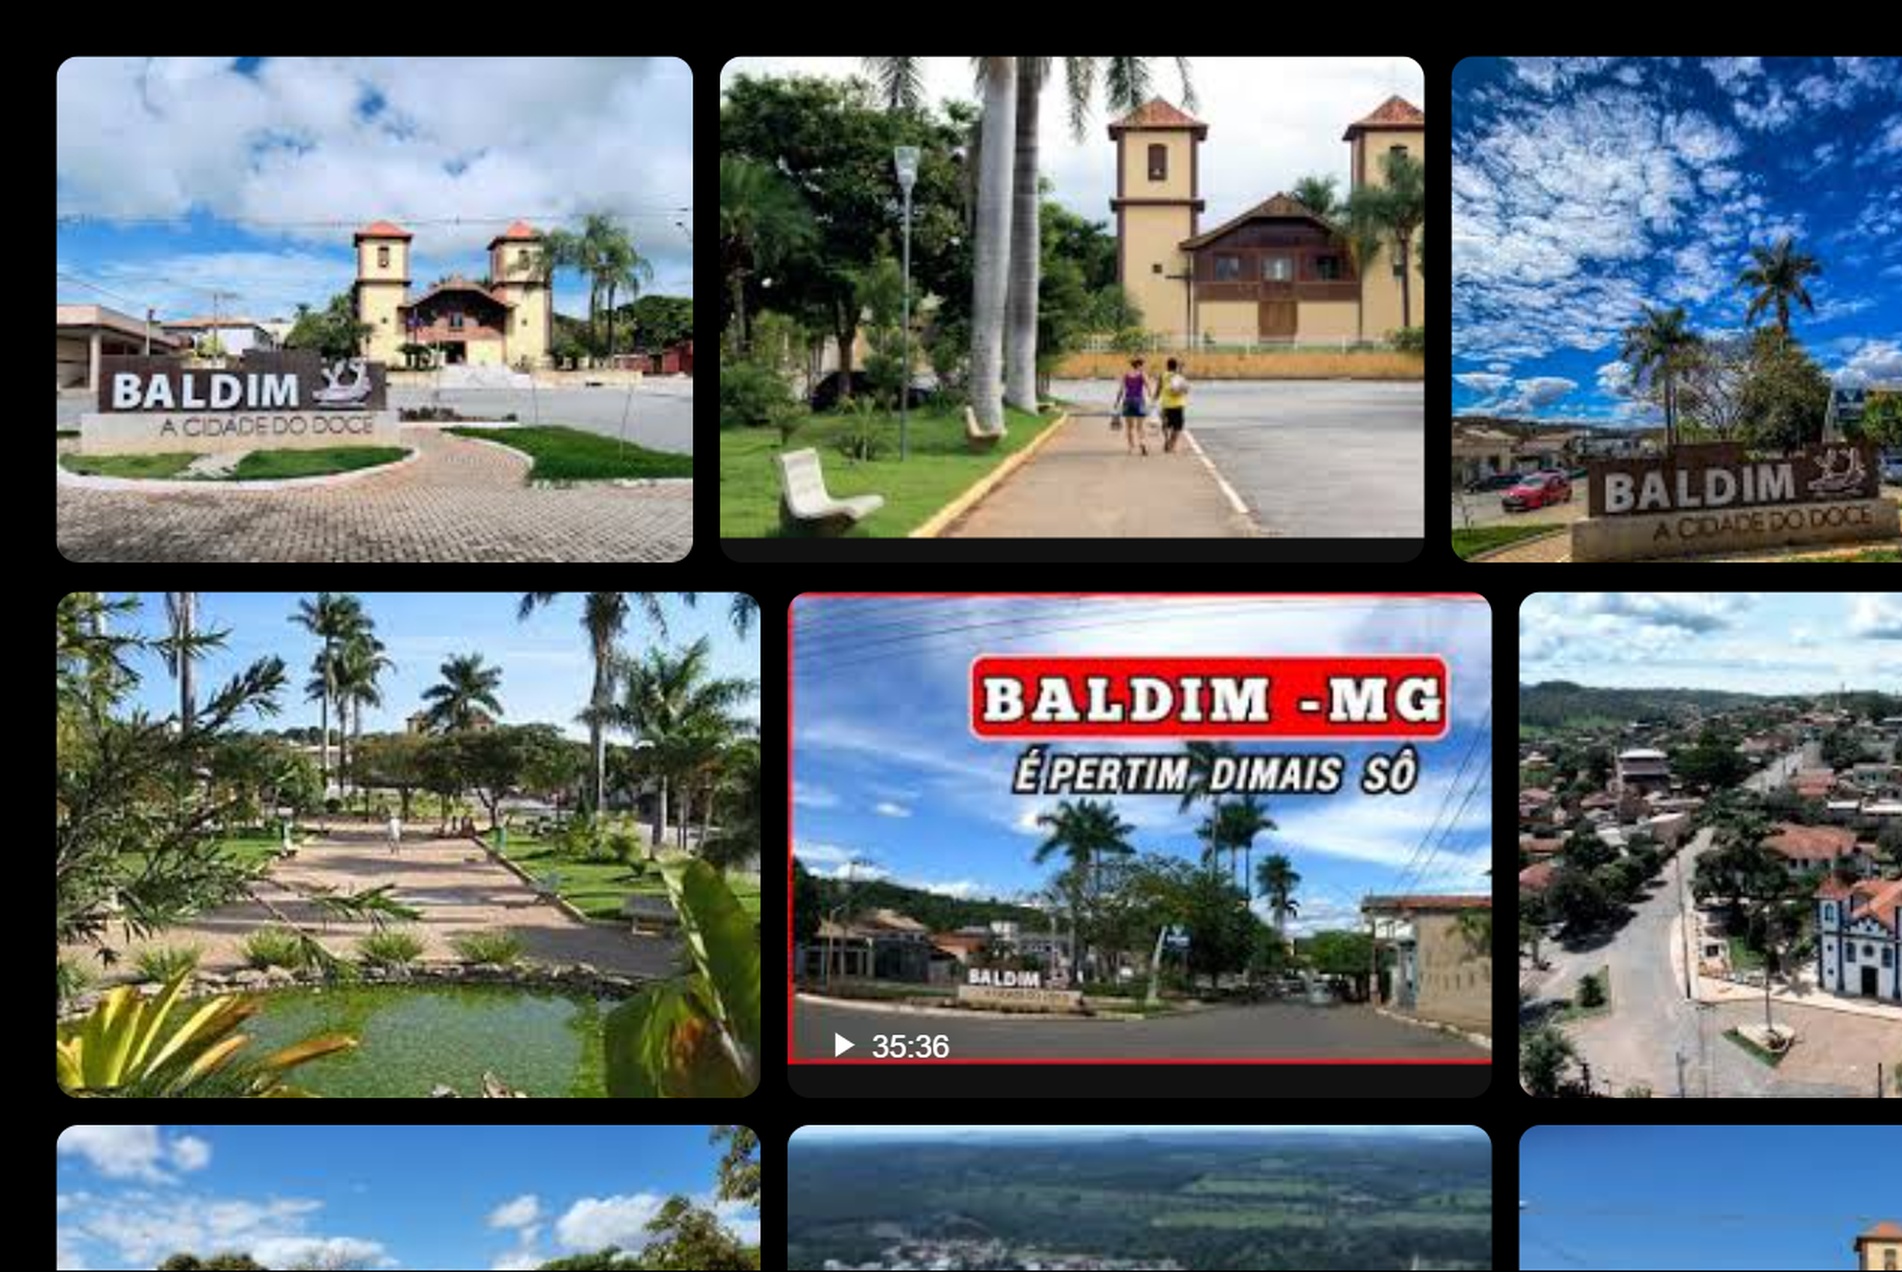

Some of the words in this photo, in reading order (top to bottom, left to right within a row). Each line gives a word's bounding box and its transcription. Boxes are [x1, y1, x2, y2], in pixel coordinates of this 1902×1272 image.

[112, 373, 300, 409] BALDIM
[160, 417, 179, 437] A
[183, 416, 267, 436] CIDADE
[272, 416, 307, 435] DO
[311, 416, 374, 435] DOCE
[1604, 463, 1796, 514] BALDIM
[1653, 521, 1672, 541] A
[1677, 512, 1764, 540] CIDADE
[1770, 508, 1804, 531] DO
[1810, 504, 1874, 528] DOCE
[968, 967, 1041, 988] BALDIM
